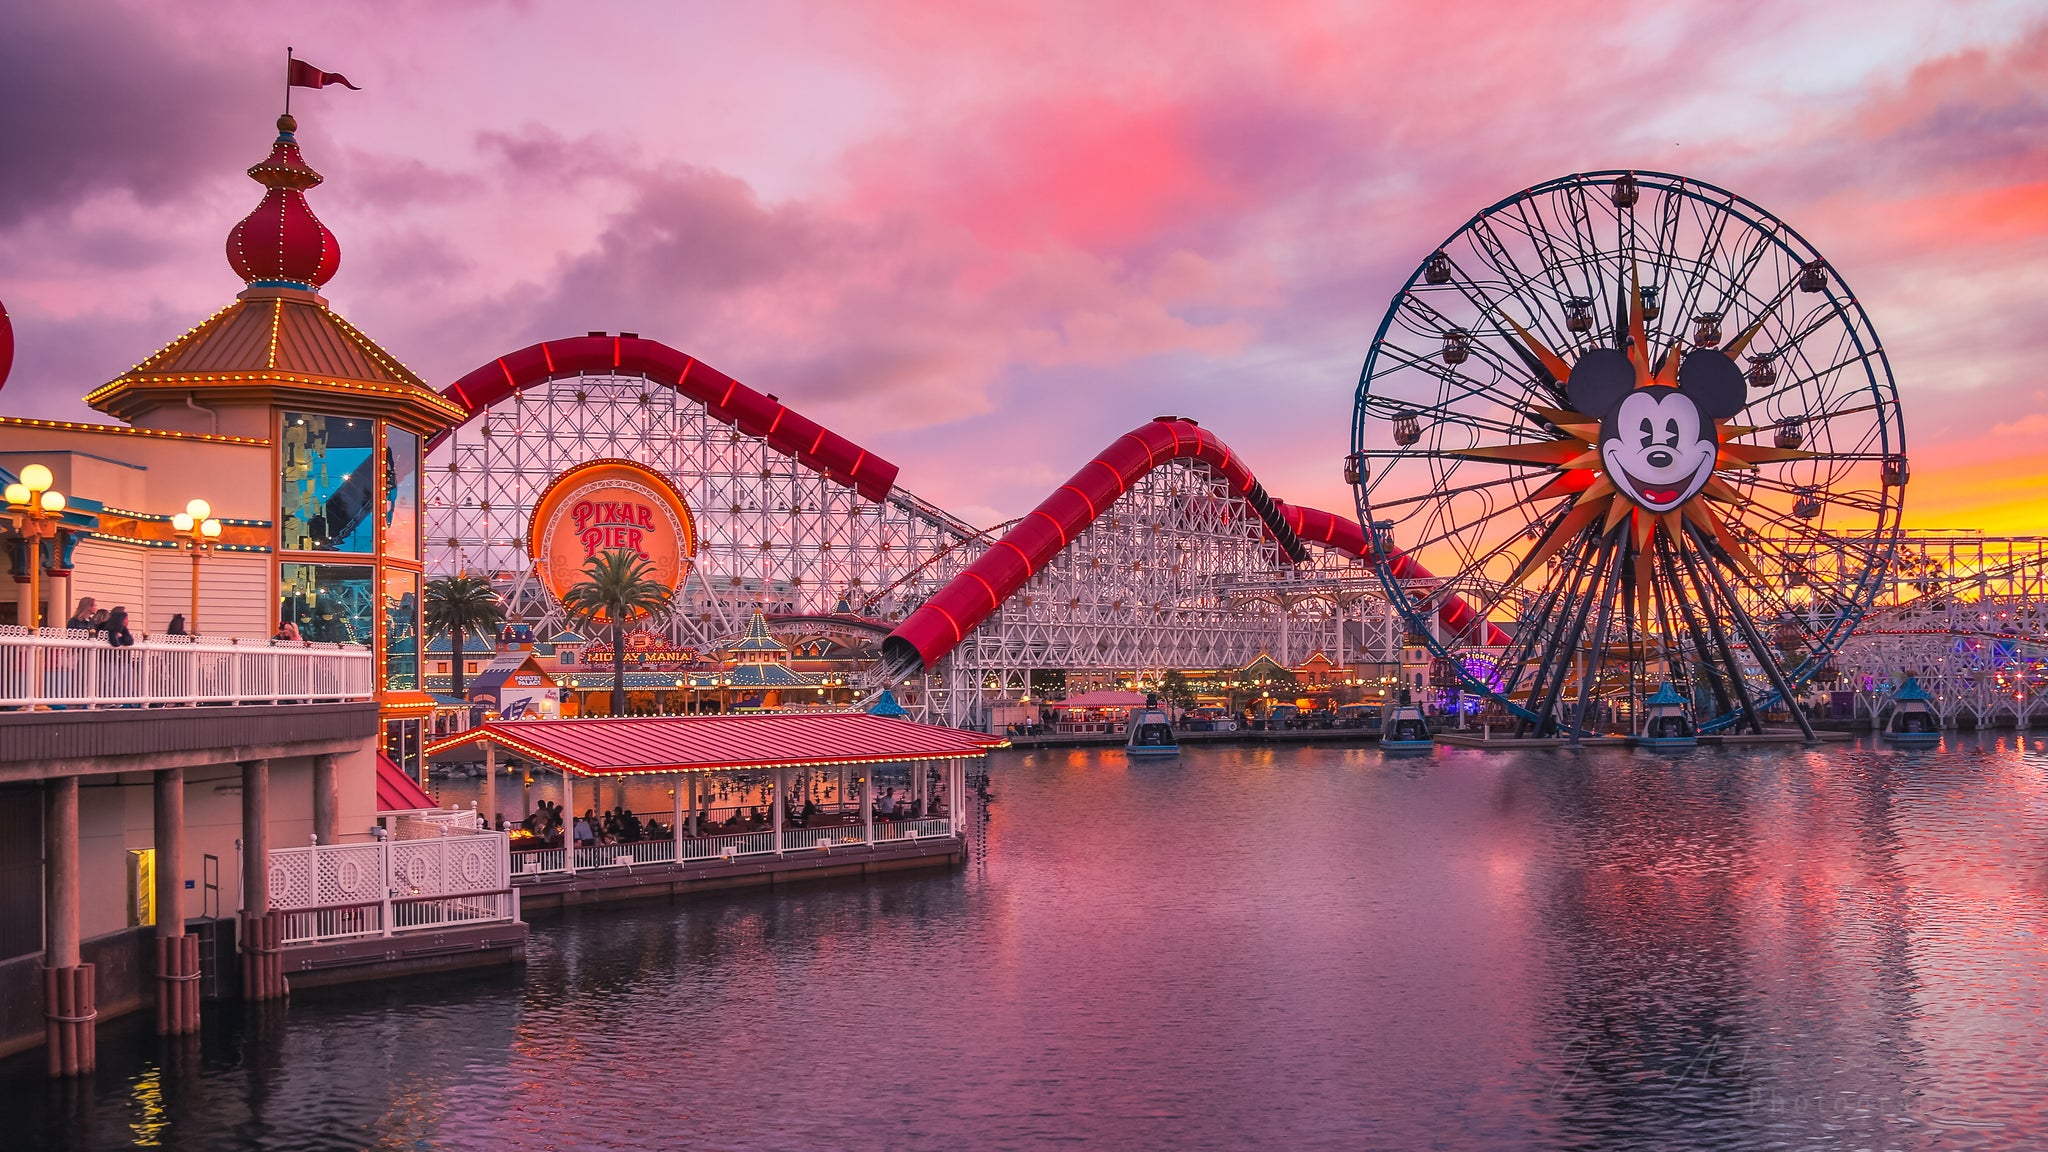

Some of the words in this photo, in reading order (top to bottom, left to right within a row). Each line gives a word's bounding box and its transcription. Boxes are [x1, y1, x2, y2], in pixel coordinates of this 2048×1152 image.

[572, 501, 655, 534] PIXAR
[581, 527, 649, 560] PIER
[587, 652, 641, 662] MIDAY
[644, 652, 693, 662] MANIA!
[514, 675, 542, 683] POULTRY
